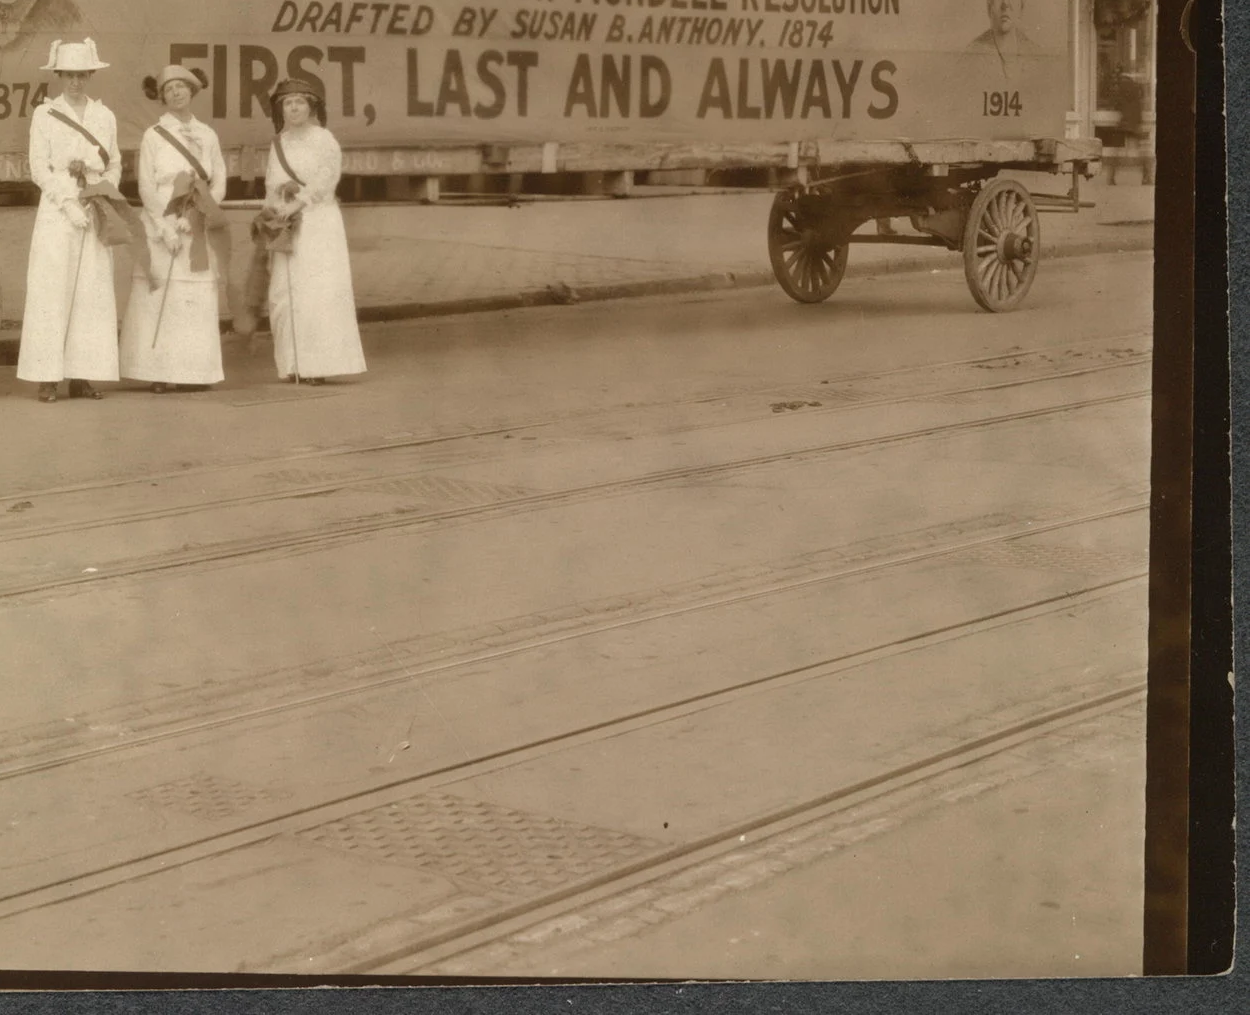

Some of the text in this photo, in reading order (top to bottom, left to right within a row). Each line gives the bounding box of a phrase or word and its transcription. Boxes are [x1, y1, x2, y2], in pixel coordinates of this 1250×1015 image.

[272, 1, 434, 36] DRAFTED
[453, 9, 498, 37] BY
[511, 10, 597, 43] SUSAN
[606, 15, 634, 43] B.
[779, 19, 834, 49] 1874
[406, 46, 539, 120] LAST
[564, 52, 671, 120] AND
[696, 57, 899, 120] ALWAYS
[983, 91, 1022, 116] 1914
